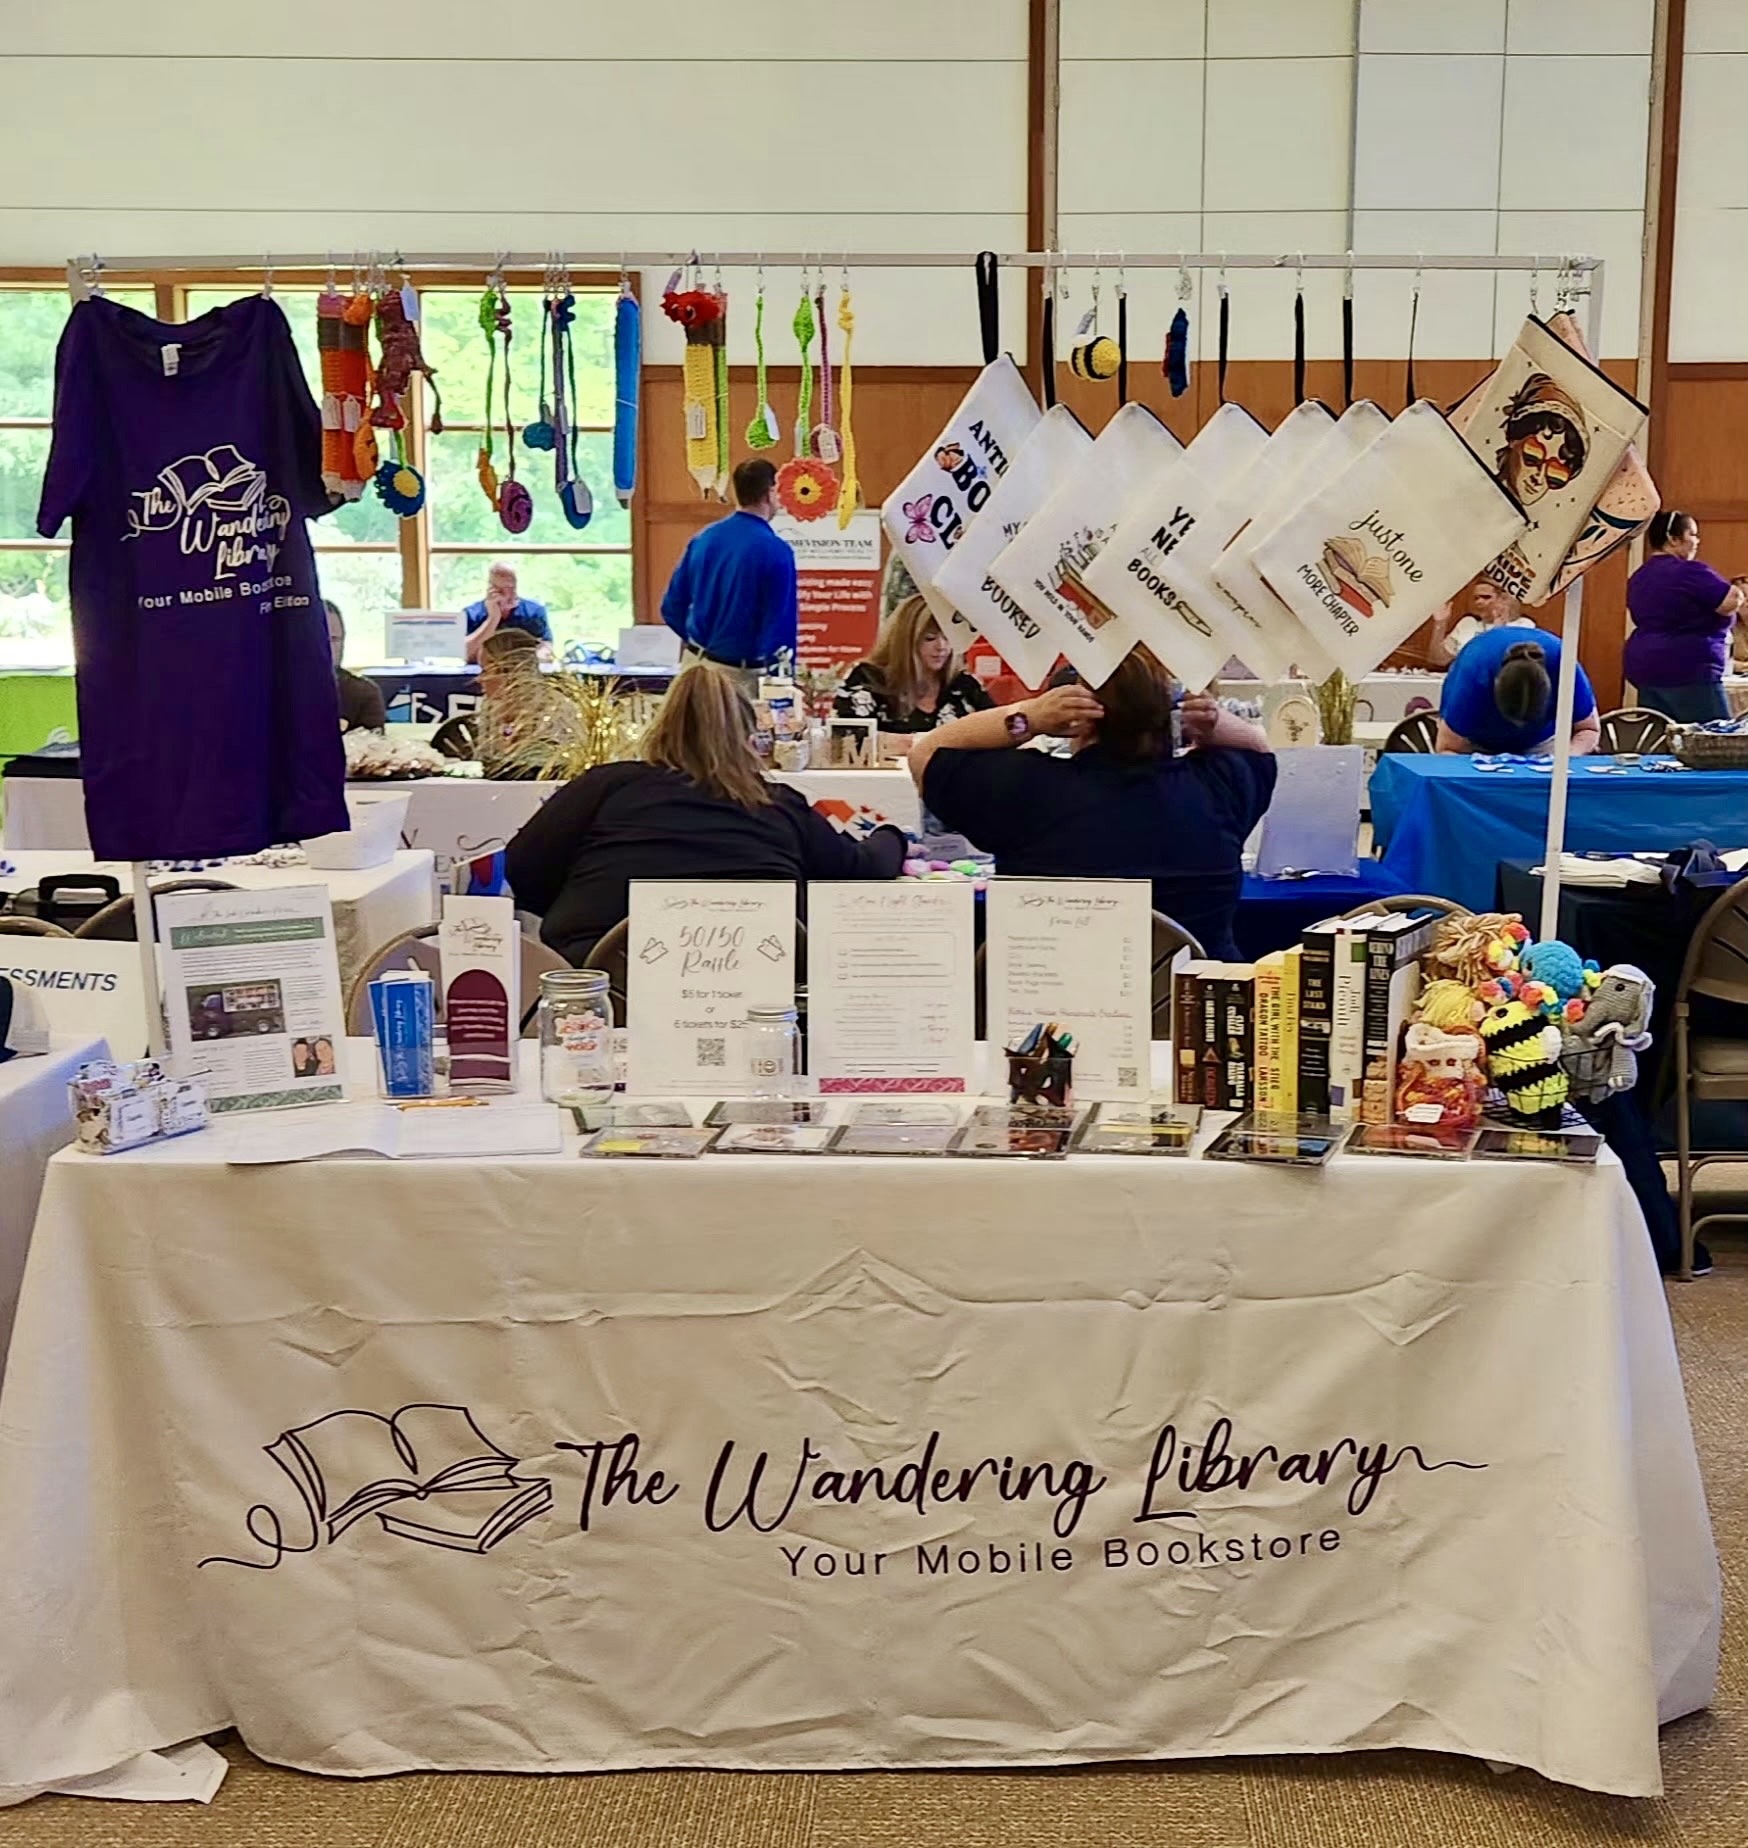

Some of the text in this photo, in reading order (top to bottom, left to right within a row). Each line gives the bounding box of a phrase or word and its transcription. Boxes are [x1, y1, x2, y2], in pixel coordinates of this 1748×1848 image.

[131, 487, 177, 525] The
[843, 539, 873, 548] TEAM
[1349, 509, 1424, 583] just one
[179, 586, 233, 604] Mobile
[1127, 558, 1177, 607] BOOKS
[1296, 563, 1360, 638] MORE CHAPTER
[679, 925, 745, 948] 50/50
[681, 949, 742, 977] Raffle
[1258, 992, 1269, 1057] DRAGON TATTOO
[1271, 986, 1280, 1061] THE GIRL WITH THE
[1258, 1066, 1269, 1102] LARSSON
[554, 1417, 1425, 1538] The Wandering Library
[781, 1527, 1341, 1577] Your Mobile Bookstore
